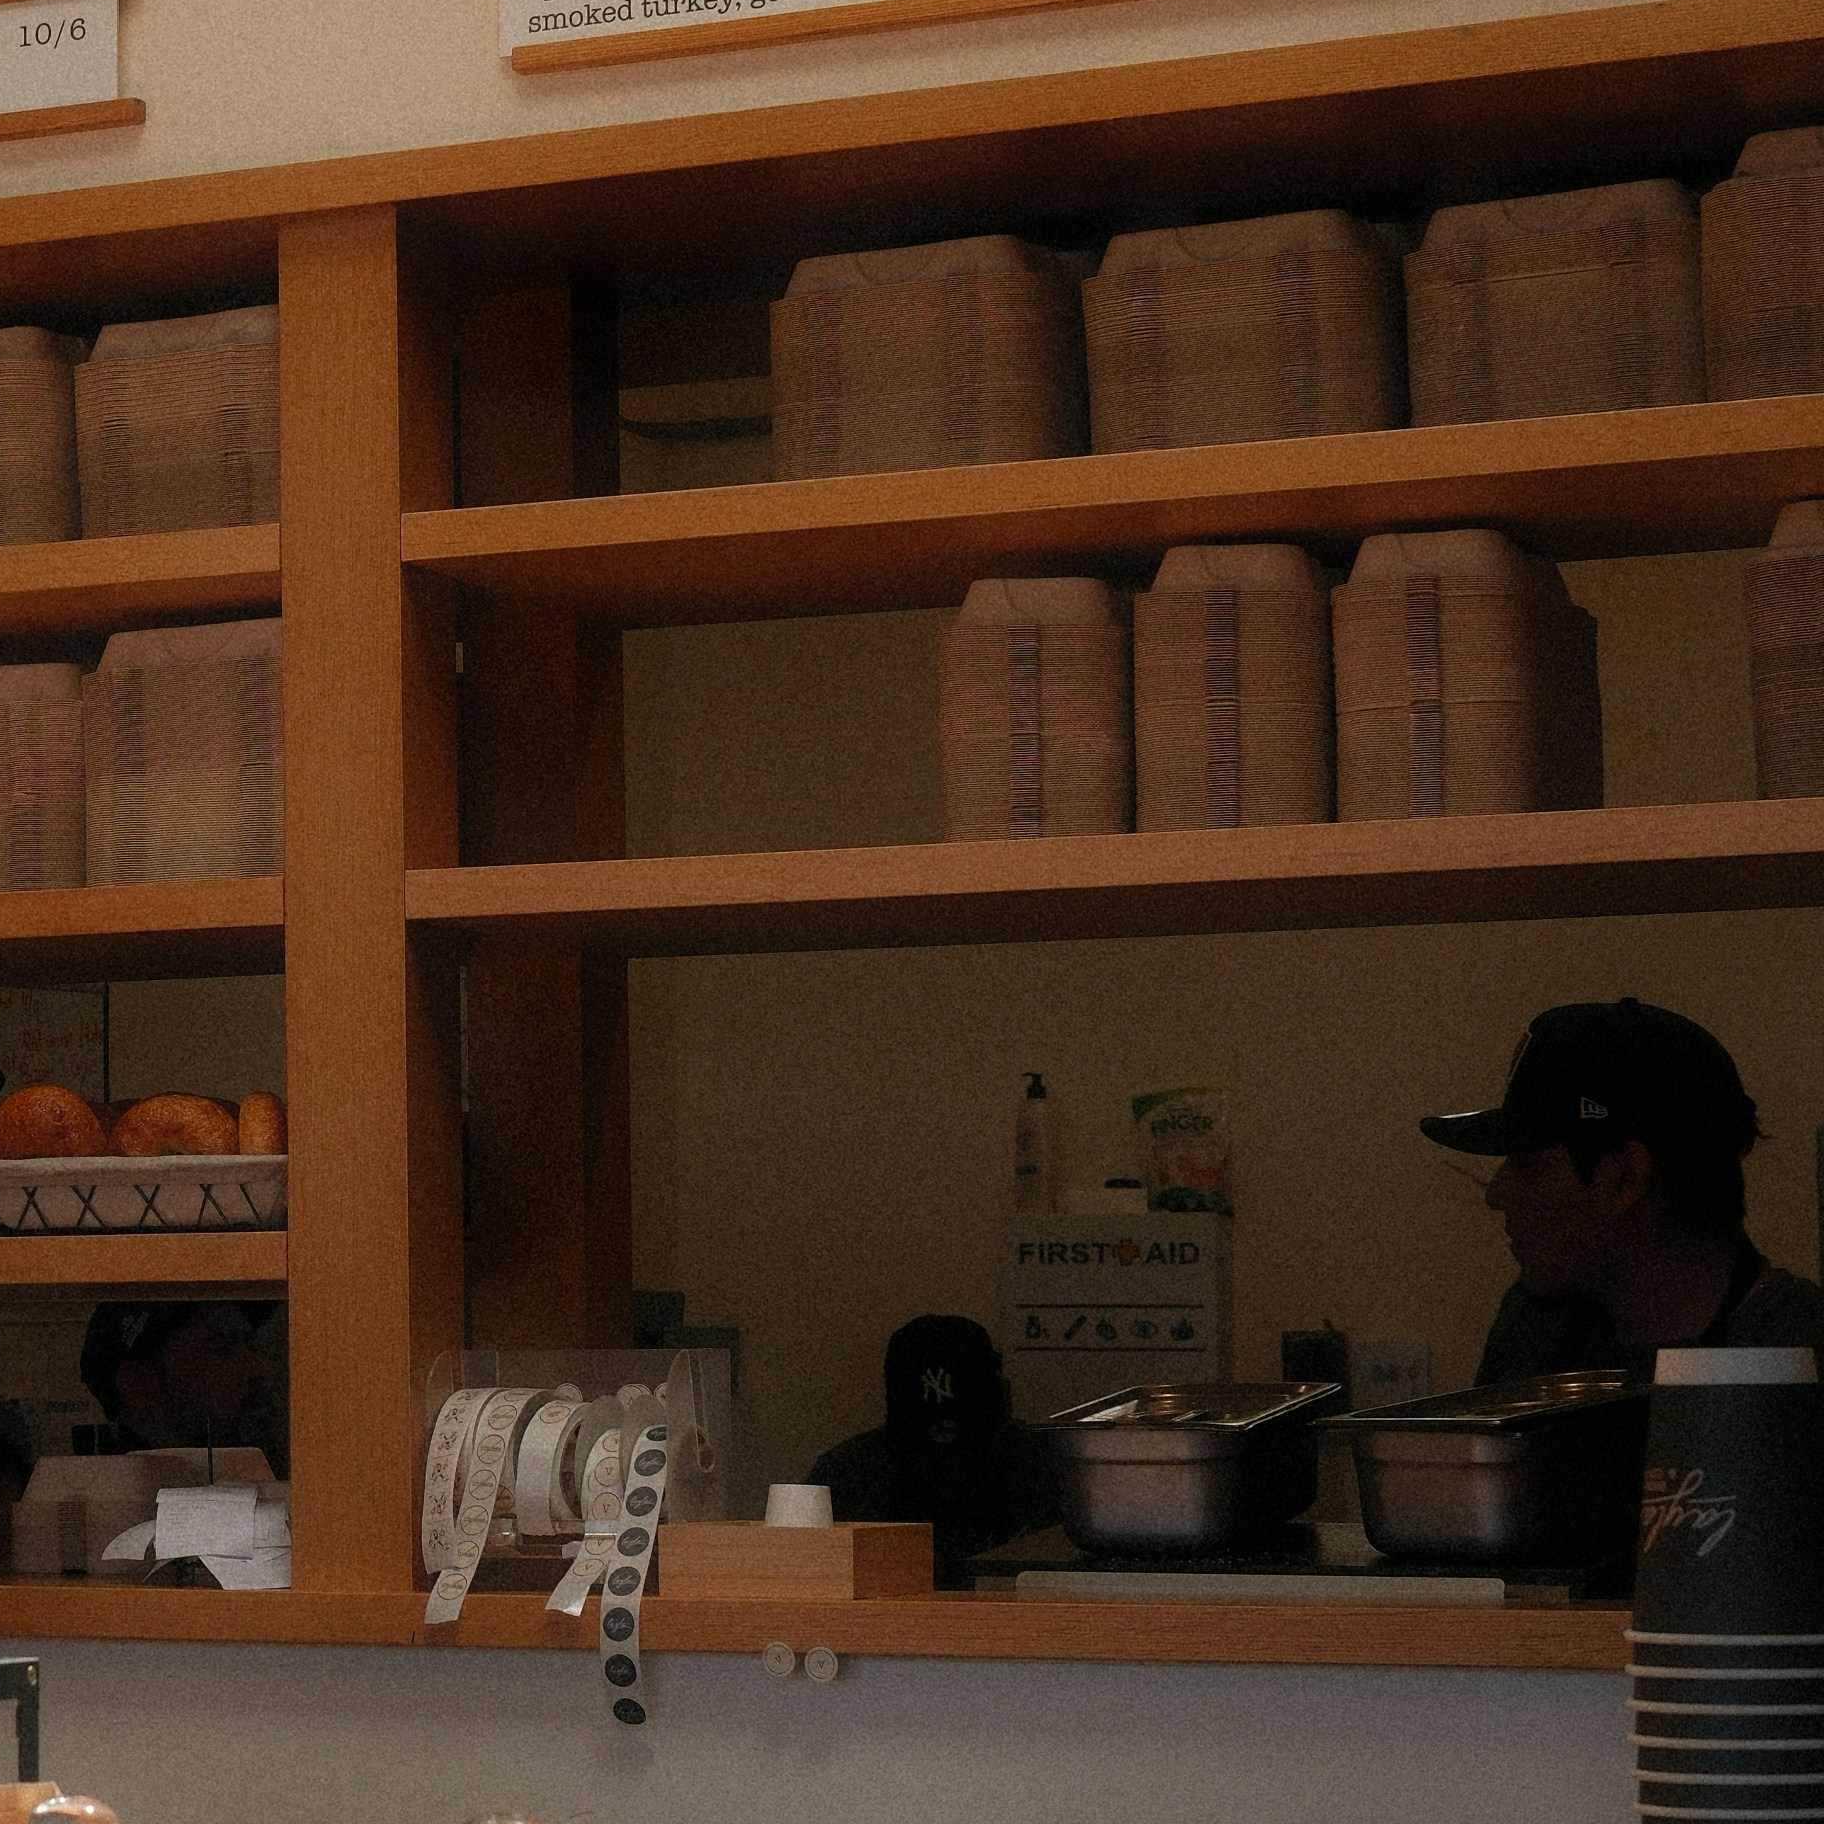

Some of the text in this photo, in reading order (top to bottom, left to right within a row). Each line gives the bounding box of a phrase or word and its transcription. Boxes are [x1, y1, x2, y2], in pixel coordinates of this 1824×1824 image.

[529, 0, 632, 32] smoked
[21, 18, 86, 47] 10/6
[1019, 1241, 1199, 1265] FIRST AID
